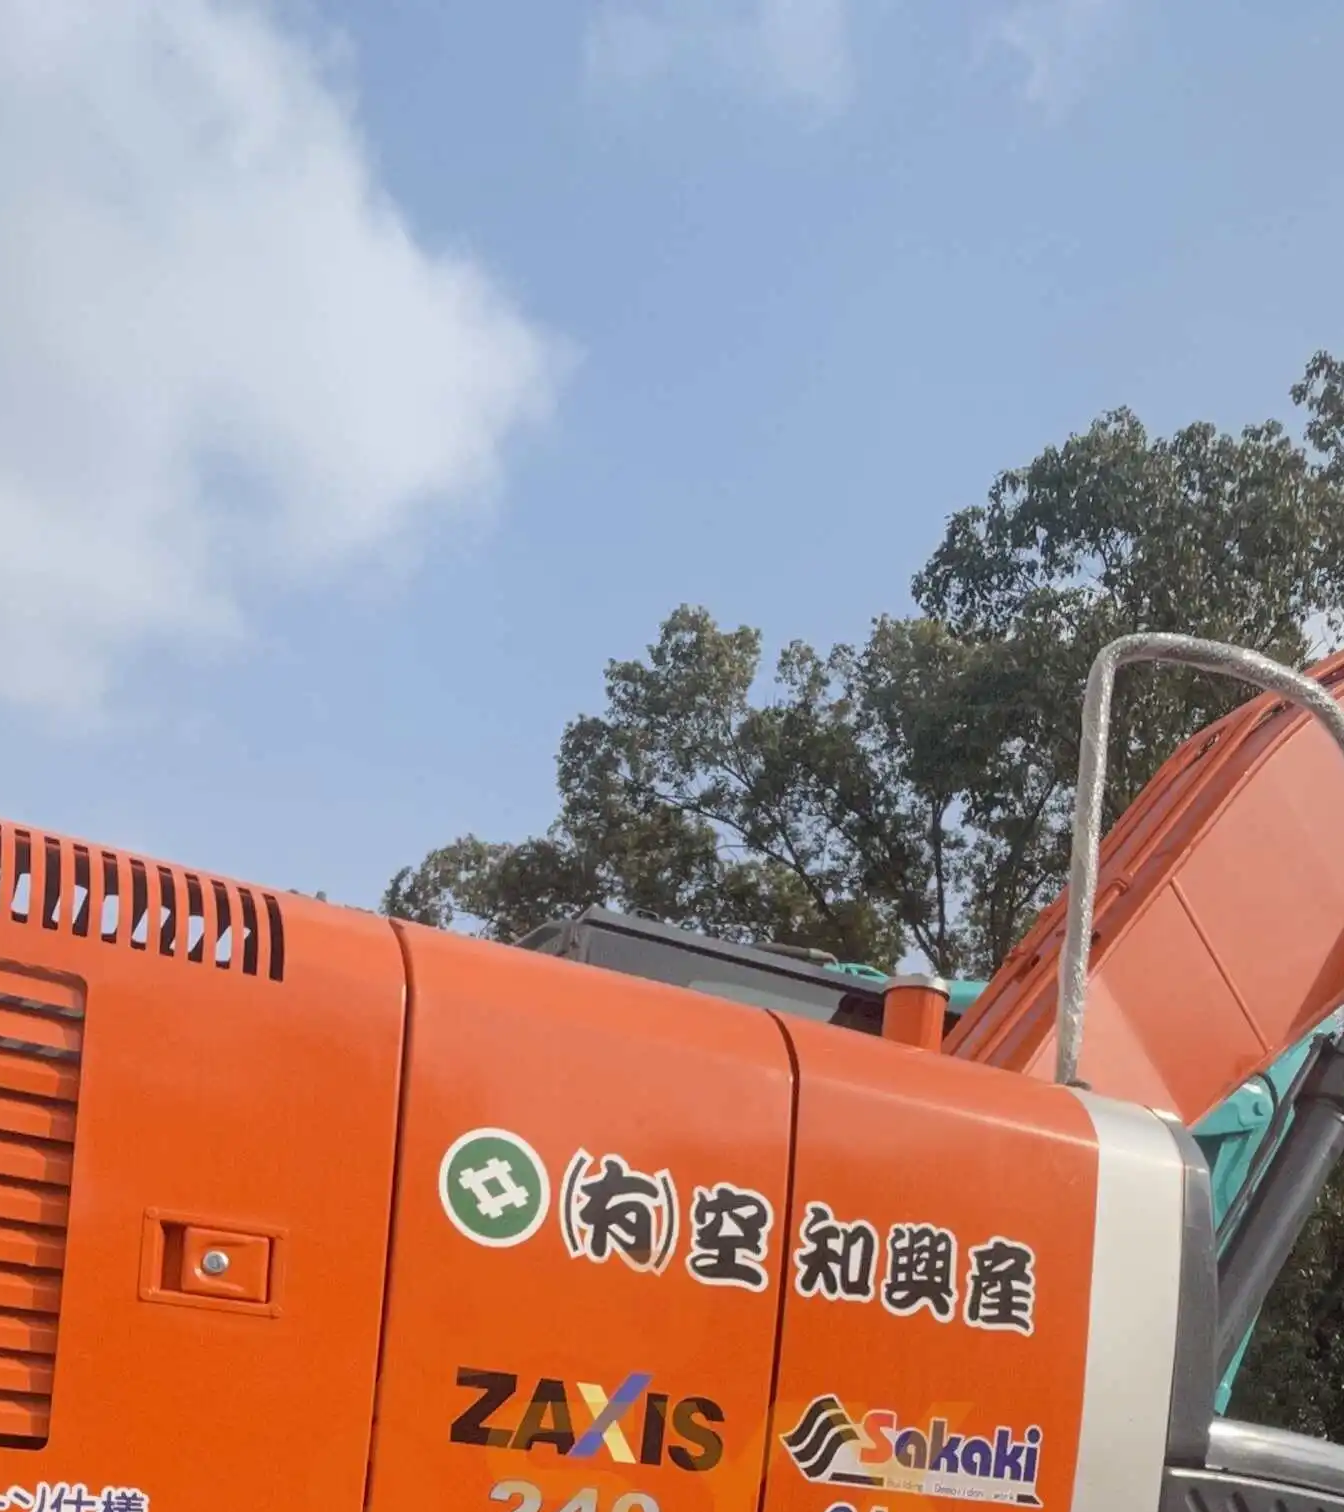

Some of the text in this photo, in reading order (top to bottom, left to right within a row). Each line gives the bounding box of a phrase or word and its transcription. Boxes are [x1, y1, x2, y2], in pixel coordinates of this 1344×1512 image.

[561, 1148, 1035, 1336] (有)空和興産
[450, 1366, 725, 1472] ZAXIS
[858, 1409, 1042, 1484] Sakaki
